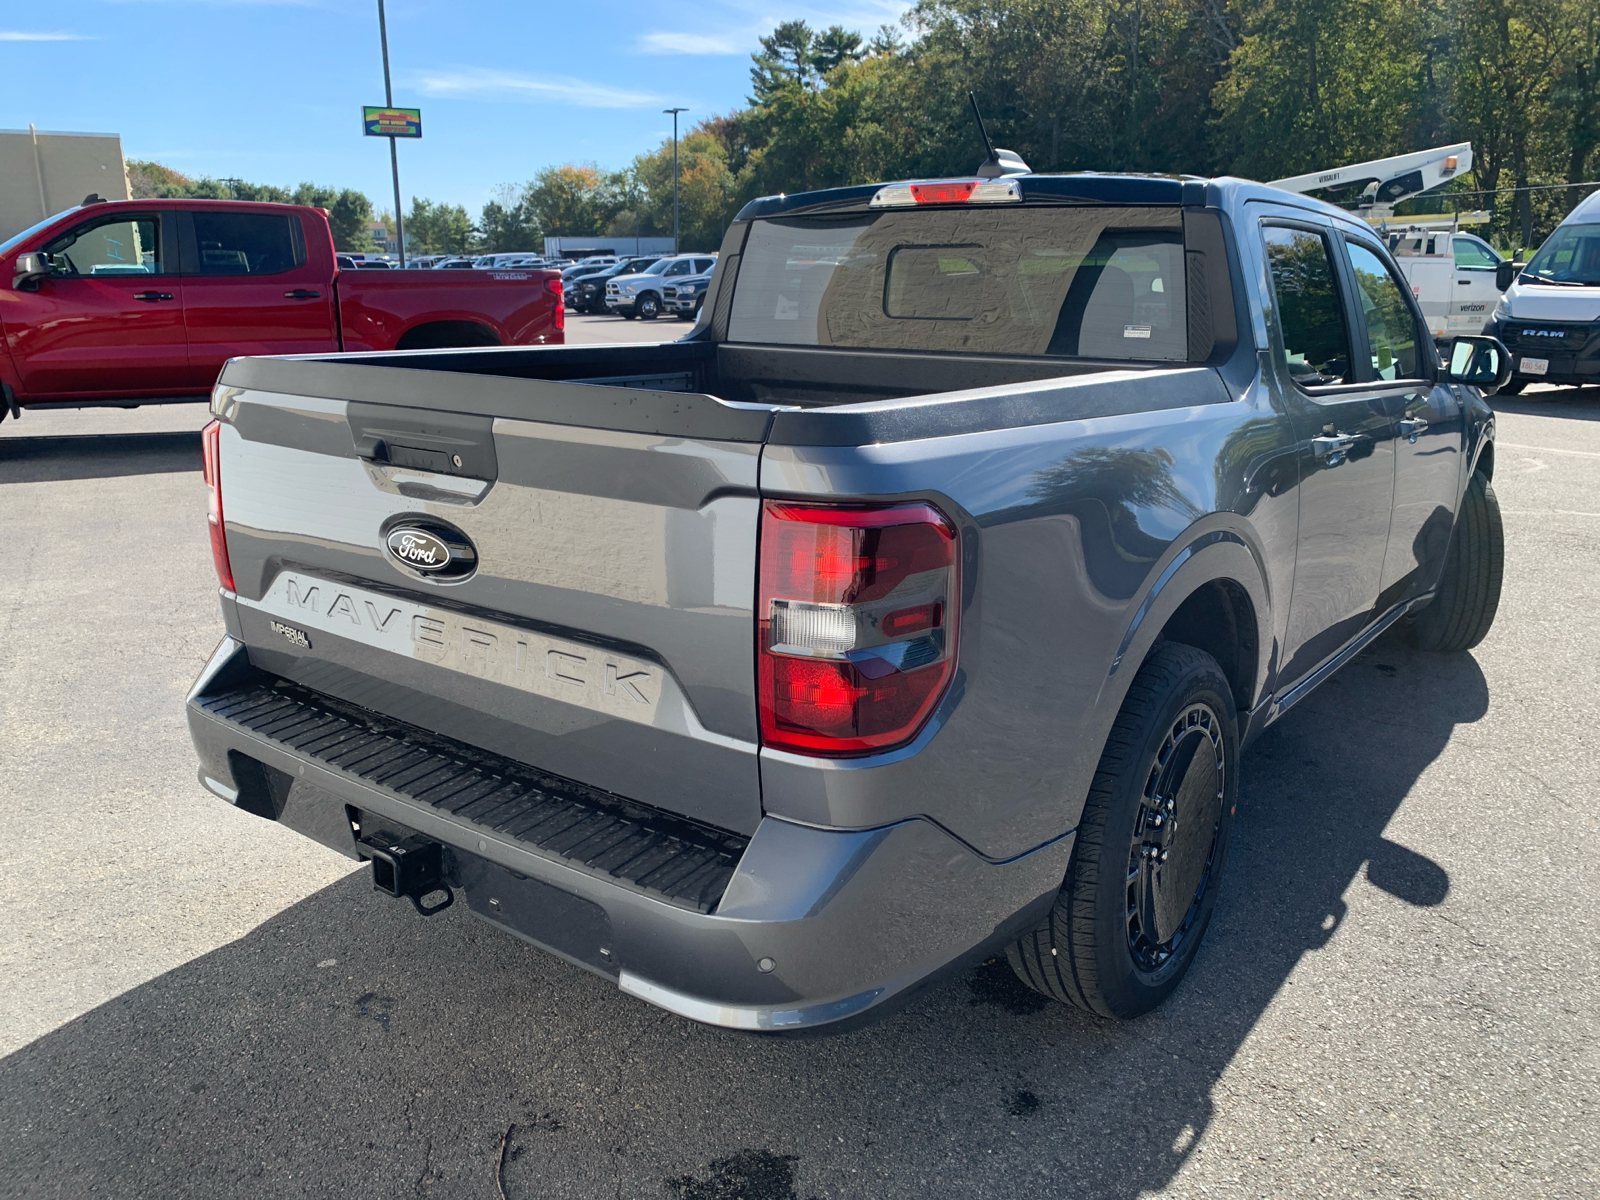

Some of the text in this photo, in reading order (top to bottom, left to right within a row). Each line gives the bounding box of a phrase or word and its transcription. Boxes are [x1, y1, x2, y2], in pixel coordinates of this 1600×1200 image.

[1318, 172, 1340, 184] VERSALIFT
[1460, 302, 1485, 312] verizon
[1522, 329, 1565, 338] RAM
[398, 534, 437, 564] Ford
[270, 620, 308, 643] IMPERIAL
[286, 578, 652, 706] MAVERICK
